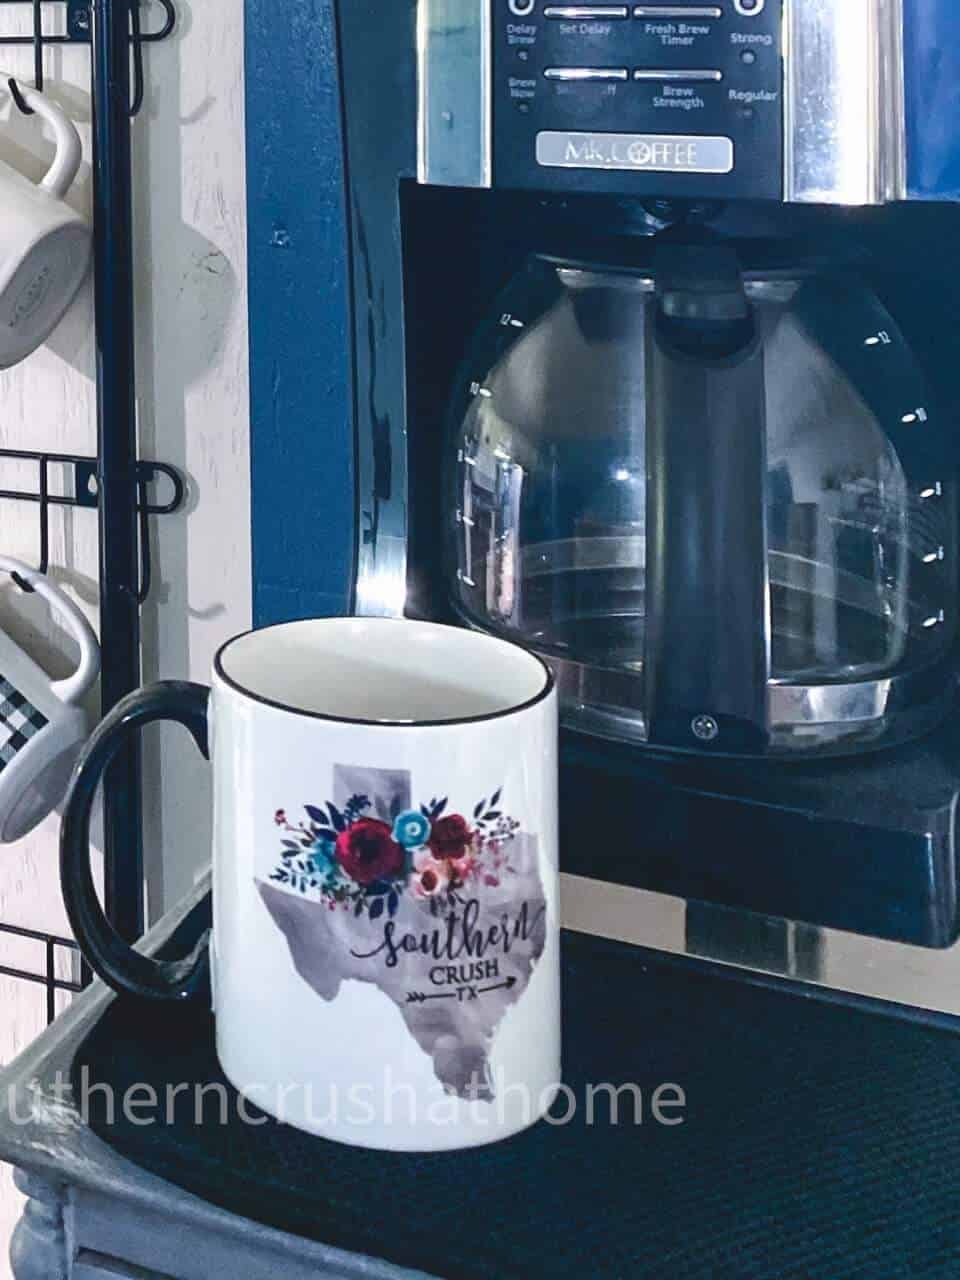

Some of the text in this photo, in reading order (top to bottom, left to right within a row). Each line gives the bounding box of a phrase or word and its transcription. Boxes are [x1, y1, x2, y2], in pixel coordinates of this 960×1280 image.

[580, 23, 611, 36] Delay
[645, 24, 711, 34] Fresh Brew
[661, 35, 695, 46] Timer
[730, 33, 773, 46] Strong
[662, 86, 695, 96] Brew
[728, 89, 778, 103] Regular
[653, 97, 705, 110] Strength
[428, 957, 501, 986] CRUSH
[455, 984, 479, 1002] TX
